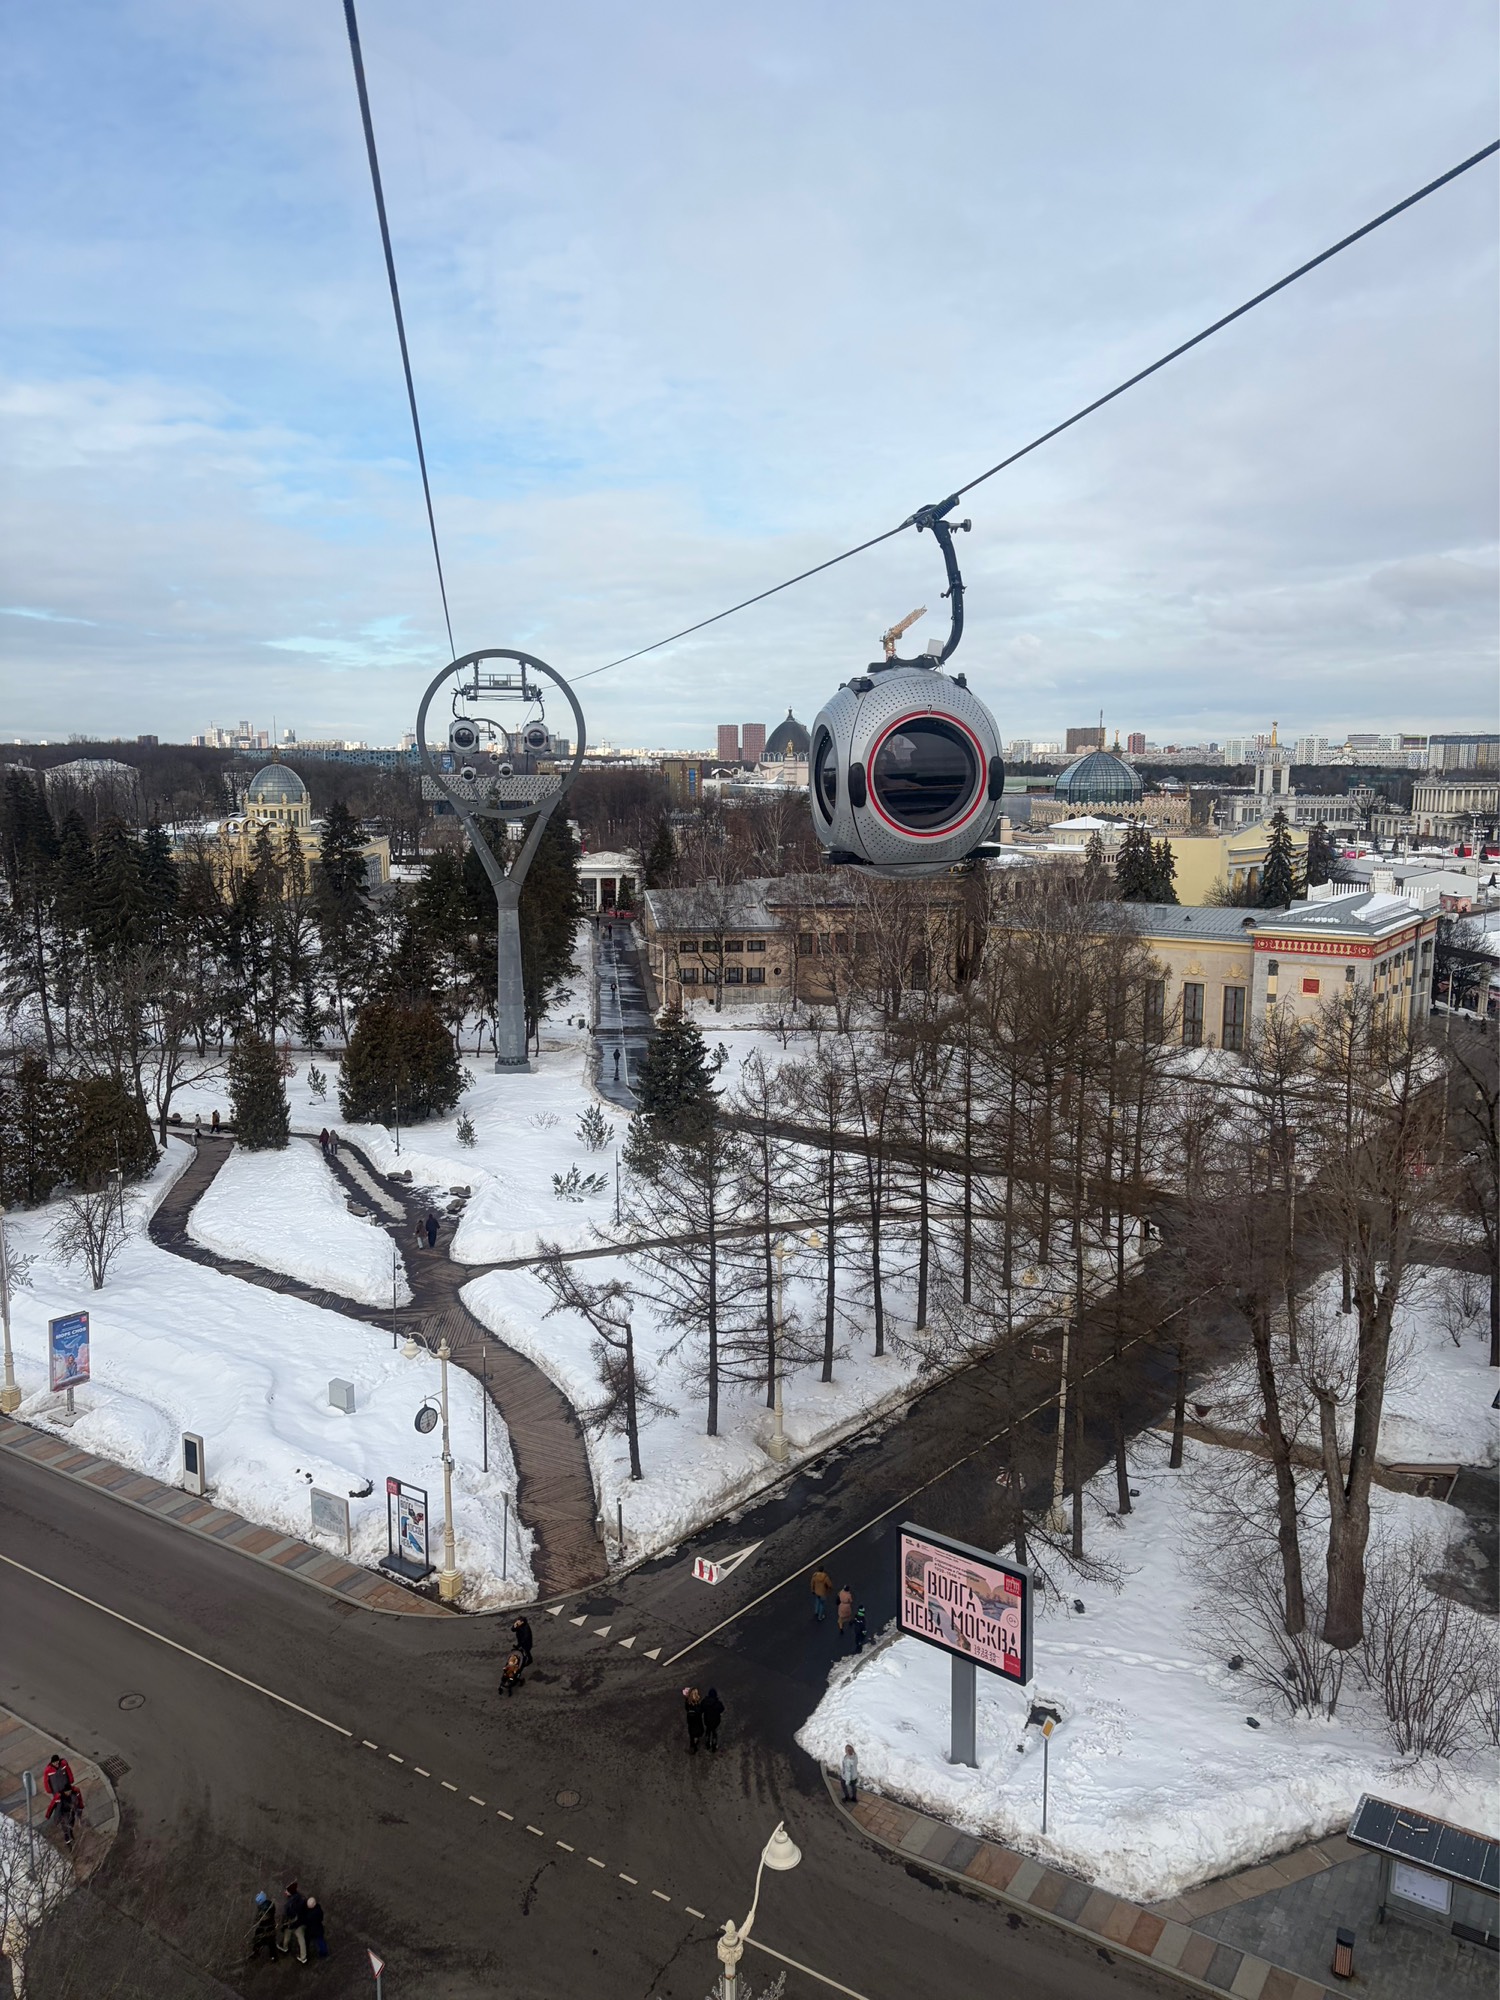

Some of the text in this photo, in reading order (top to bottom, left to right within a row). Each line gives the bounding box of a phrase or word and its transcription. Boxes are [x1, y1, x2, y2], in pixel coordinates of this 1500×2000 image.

[927, 1570, 976, 1613] ВОЛГА
[905, 1599, 944, 1638] НЕВА
[951, 1607, 1019, 1658] МОСКВА
